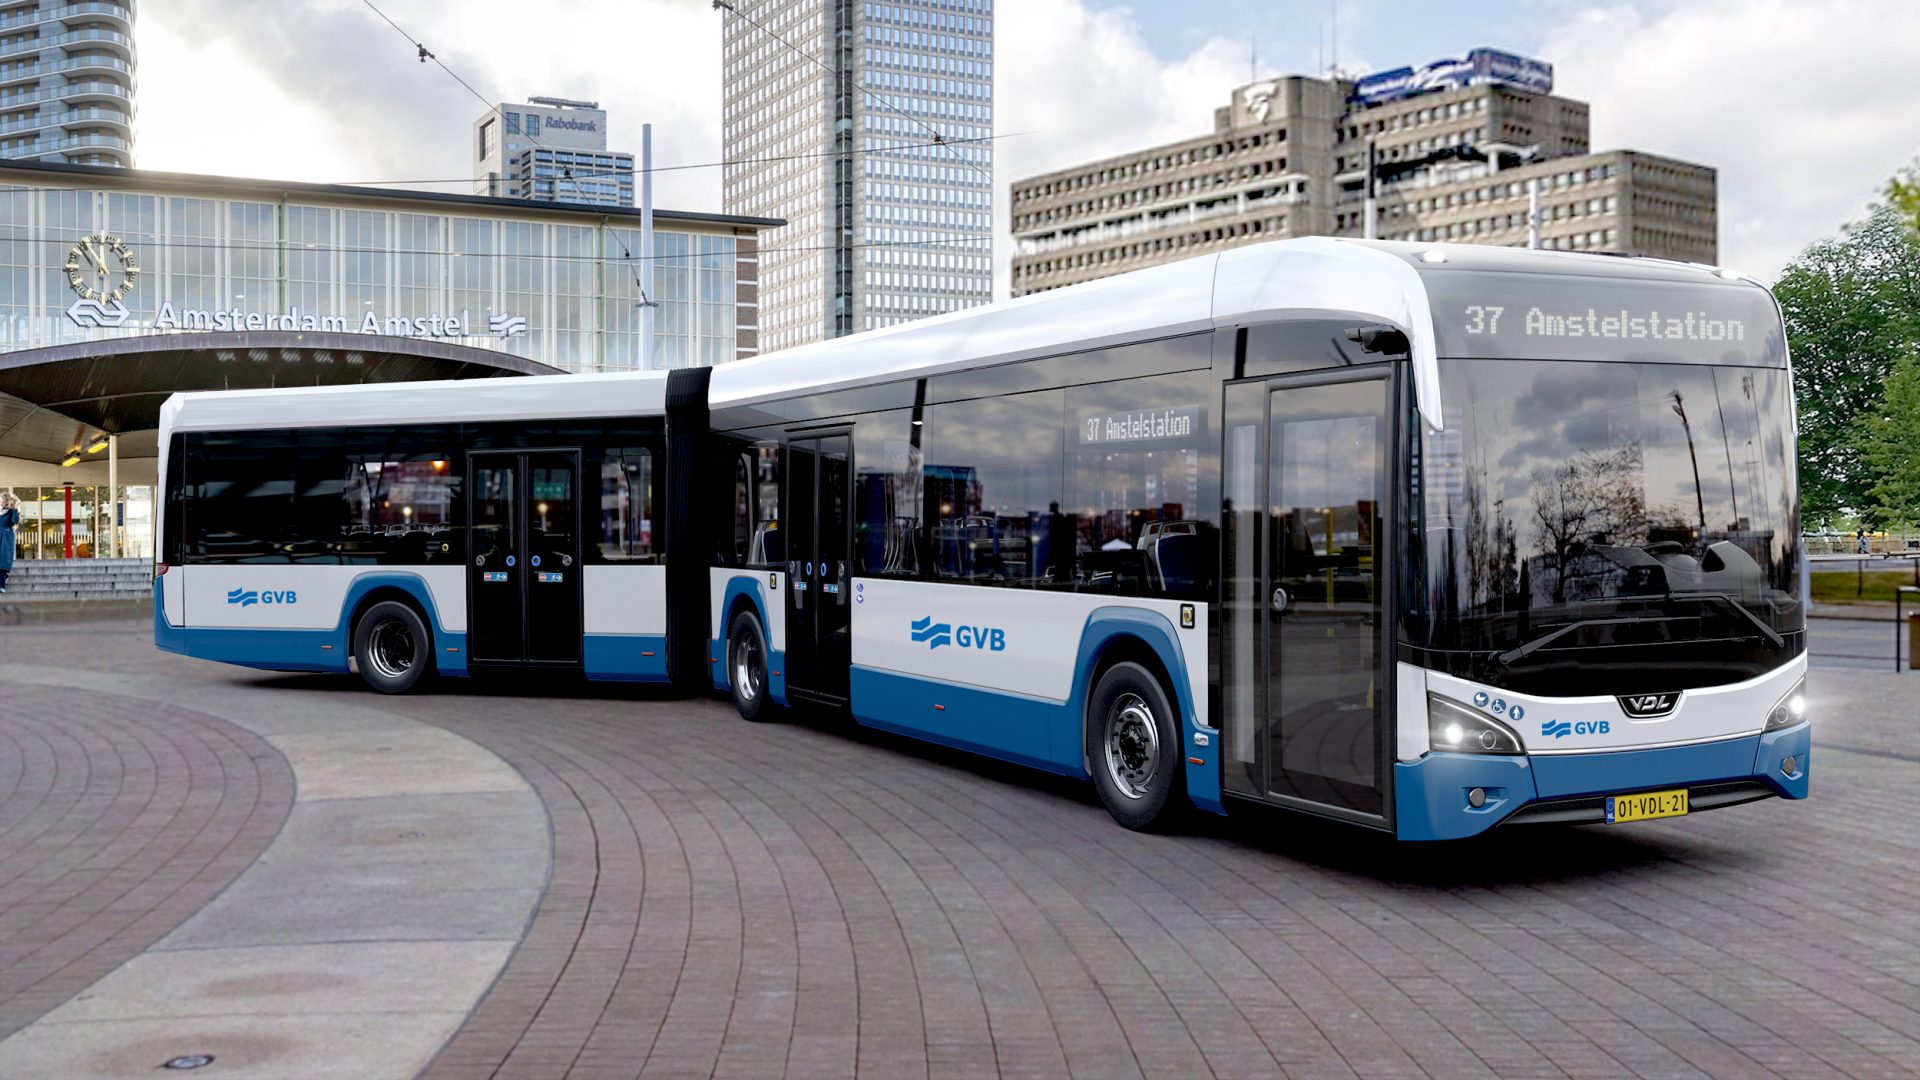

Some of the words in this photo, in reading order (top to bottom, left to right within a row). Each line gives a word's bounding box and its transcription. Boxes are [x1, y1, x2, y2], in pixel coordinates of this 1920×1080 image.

[545, 116, 597, 132] Rabobank
[154, 300, 347, 332] Amsterdam
[359, 309, 470, 337] Amstel
[1465, 305, 1504, 334] 37
[1526, 307, 1744, 341] Amstelstation
[1087, 418, 1100, 441] 37
[1106, 410, 1190, 440] Amstelstation
[261, 591, 297, 604] GVB
[956, 625, 1006, 652] GVB
[1629, 695, 1670, 711] VDL
[1574, 721, 1610, 734] GVB
[1618, 794, 1684, 818] 01-VDL-21
